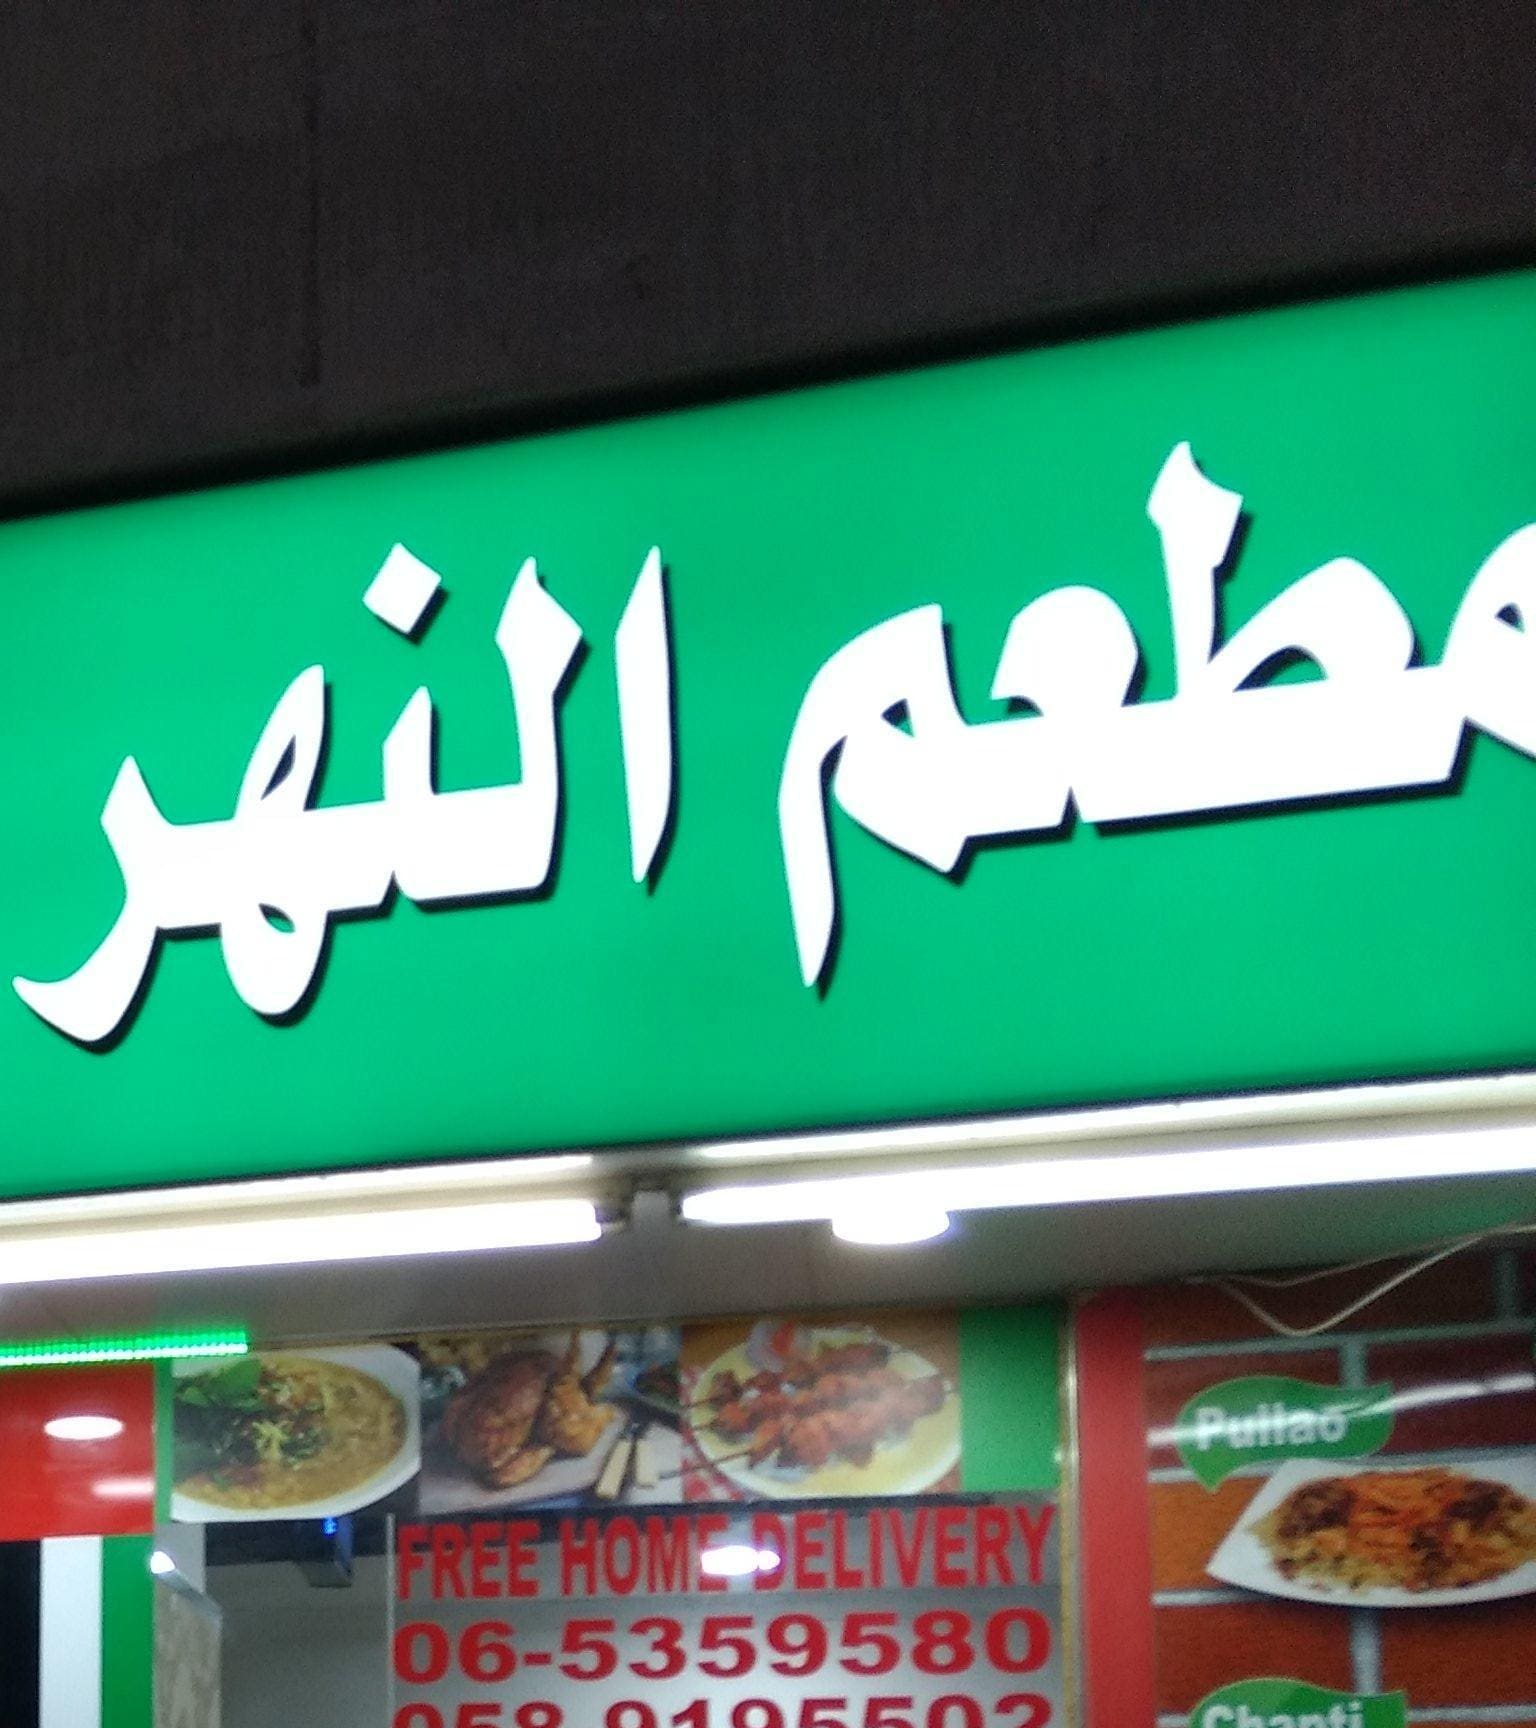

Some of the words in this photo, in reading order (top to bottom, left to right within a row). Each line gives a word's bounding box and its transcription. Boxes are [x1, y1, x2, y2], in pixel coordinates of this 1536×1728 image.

[778, 442, 1536, 986] مطعم
[13, 543, 672, 1043] النهر
[1196, 1402, 1348, 1450] Pullao
[397, 1522, 540, 1600] FREE
[561, 1513, 728, 1596] HOME
[752, 1504, 1056, 1592] DELIVERY
[391, 1607, 1054, 1684] 06-5359580
